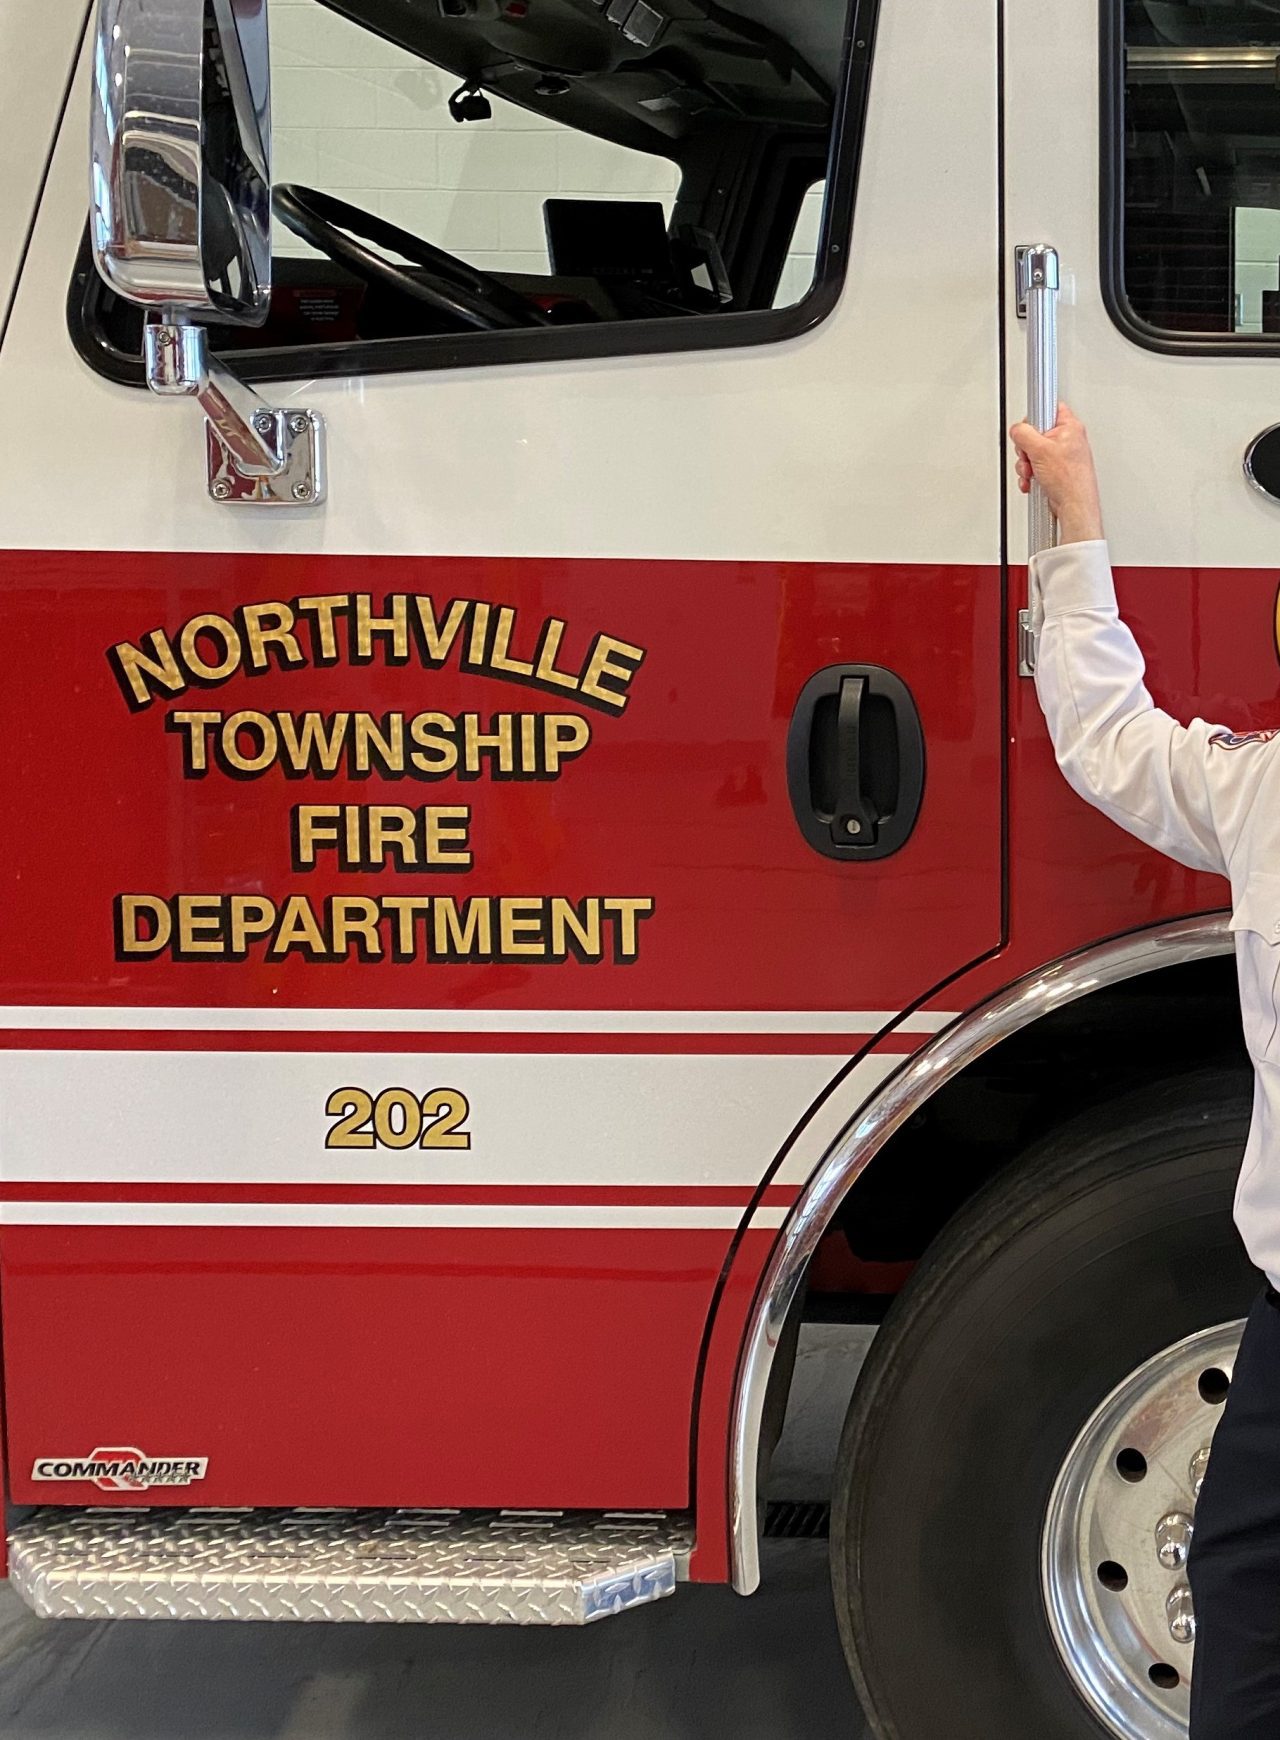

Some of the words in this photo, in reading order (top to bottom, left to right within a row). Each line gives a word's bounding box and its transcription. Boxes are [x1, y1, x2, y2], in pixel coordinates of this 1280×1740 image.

[107, 593, 646, 715] NORTHVILLE
[165, 710, 592, 781] TOWNSHIP
[291, 804, 473, 872] FIRE
[114, 894, 655, 964] DEPARTMENT
[325, 1086, 471, 1150] 202
[37, 1461, 200, 1477] COMMANDER
